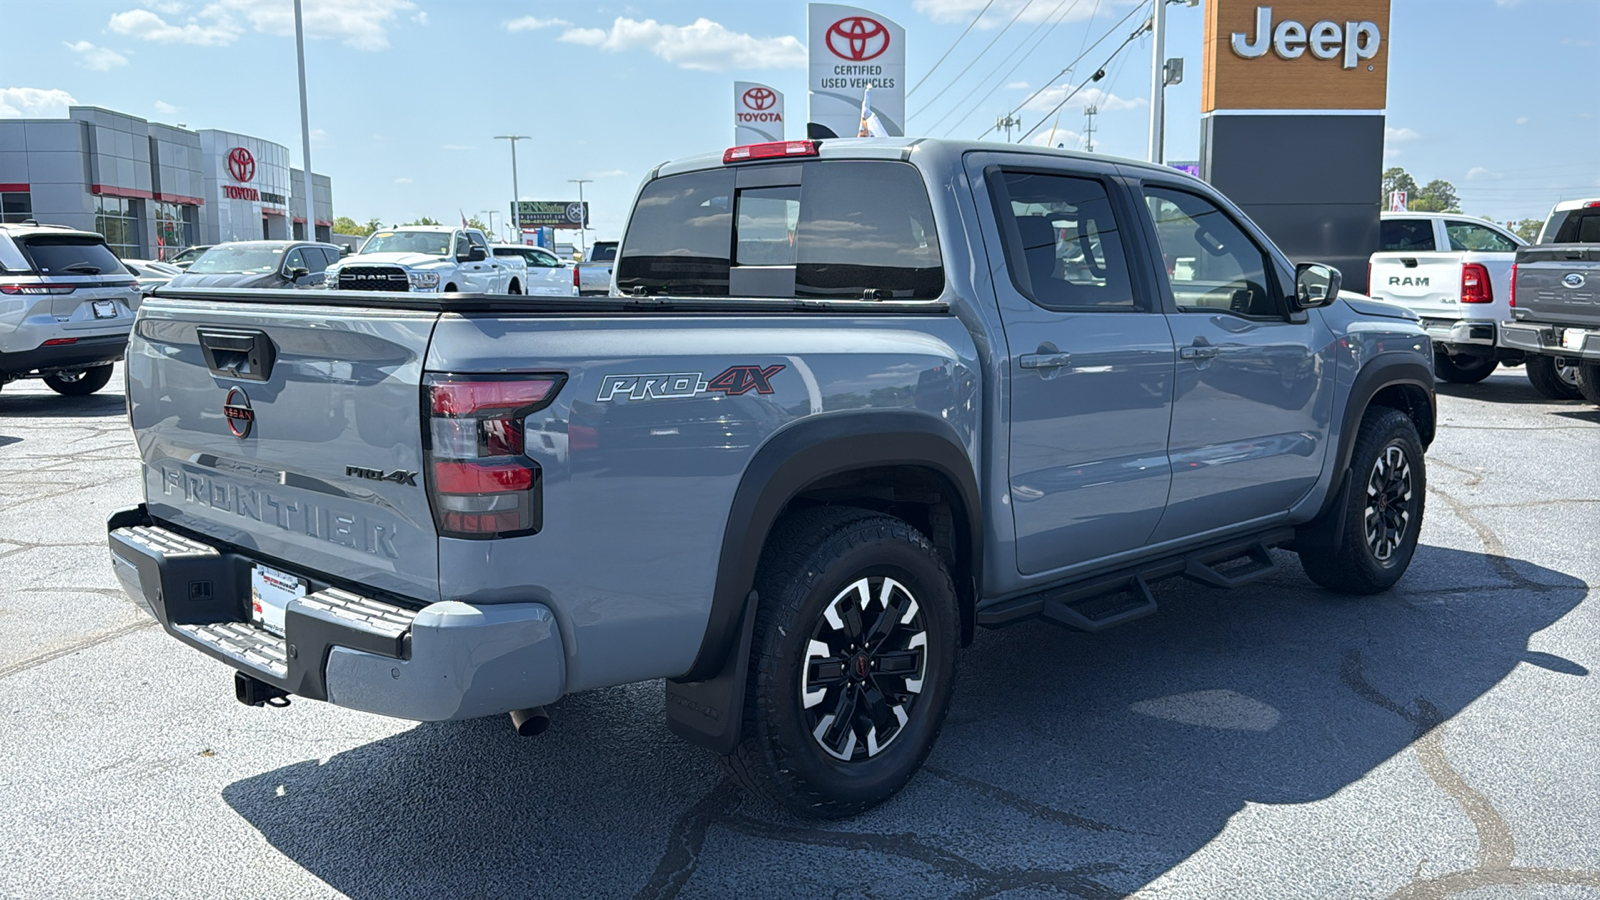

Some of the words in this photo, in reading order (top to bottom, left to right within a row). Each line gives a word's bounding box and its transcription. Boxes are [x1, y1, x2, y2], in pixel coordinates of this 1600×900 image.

[1231, 6, 1381, 69] Jeep
[834, 65, 882, 76] CERTIFIED
[821, 78, 847, 89] USED
[850, 78, 895, 89] VEHICLES
[737, 113, 782, 123] TOYOTA
[223, 185, 259, 202] TOYOTA
[1389, 276, 1430, 287] RAM
[596, 364, 787, 402] PRO-4X
[224, 406, 252, 420] NISSAN
[162, 465, 399, 560] FRONTIER
